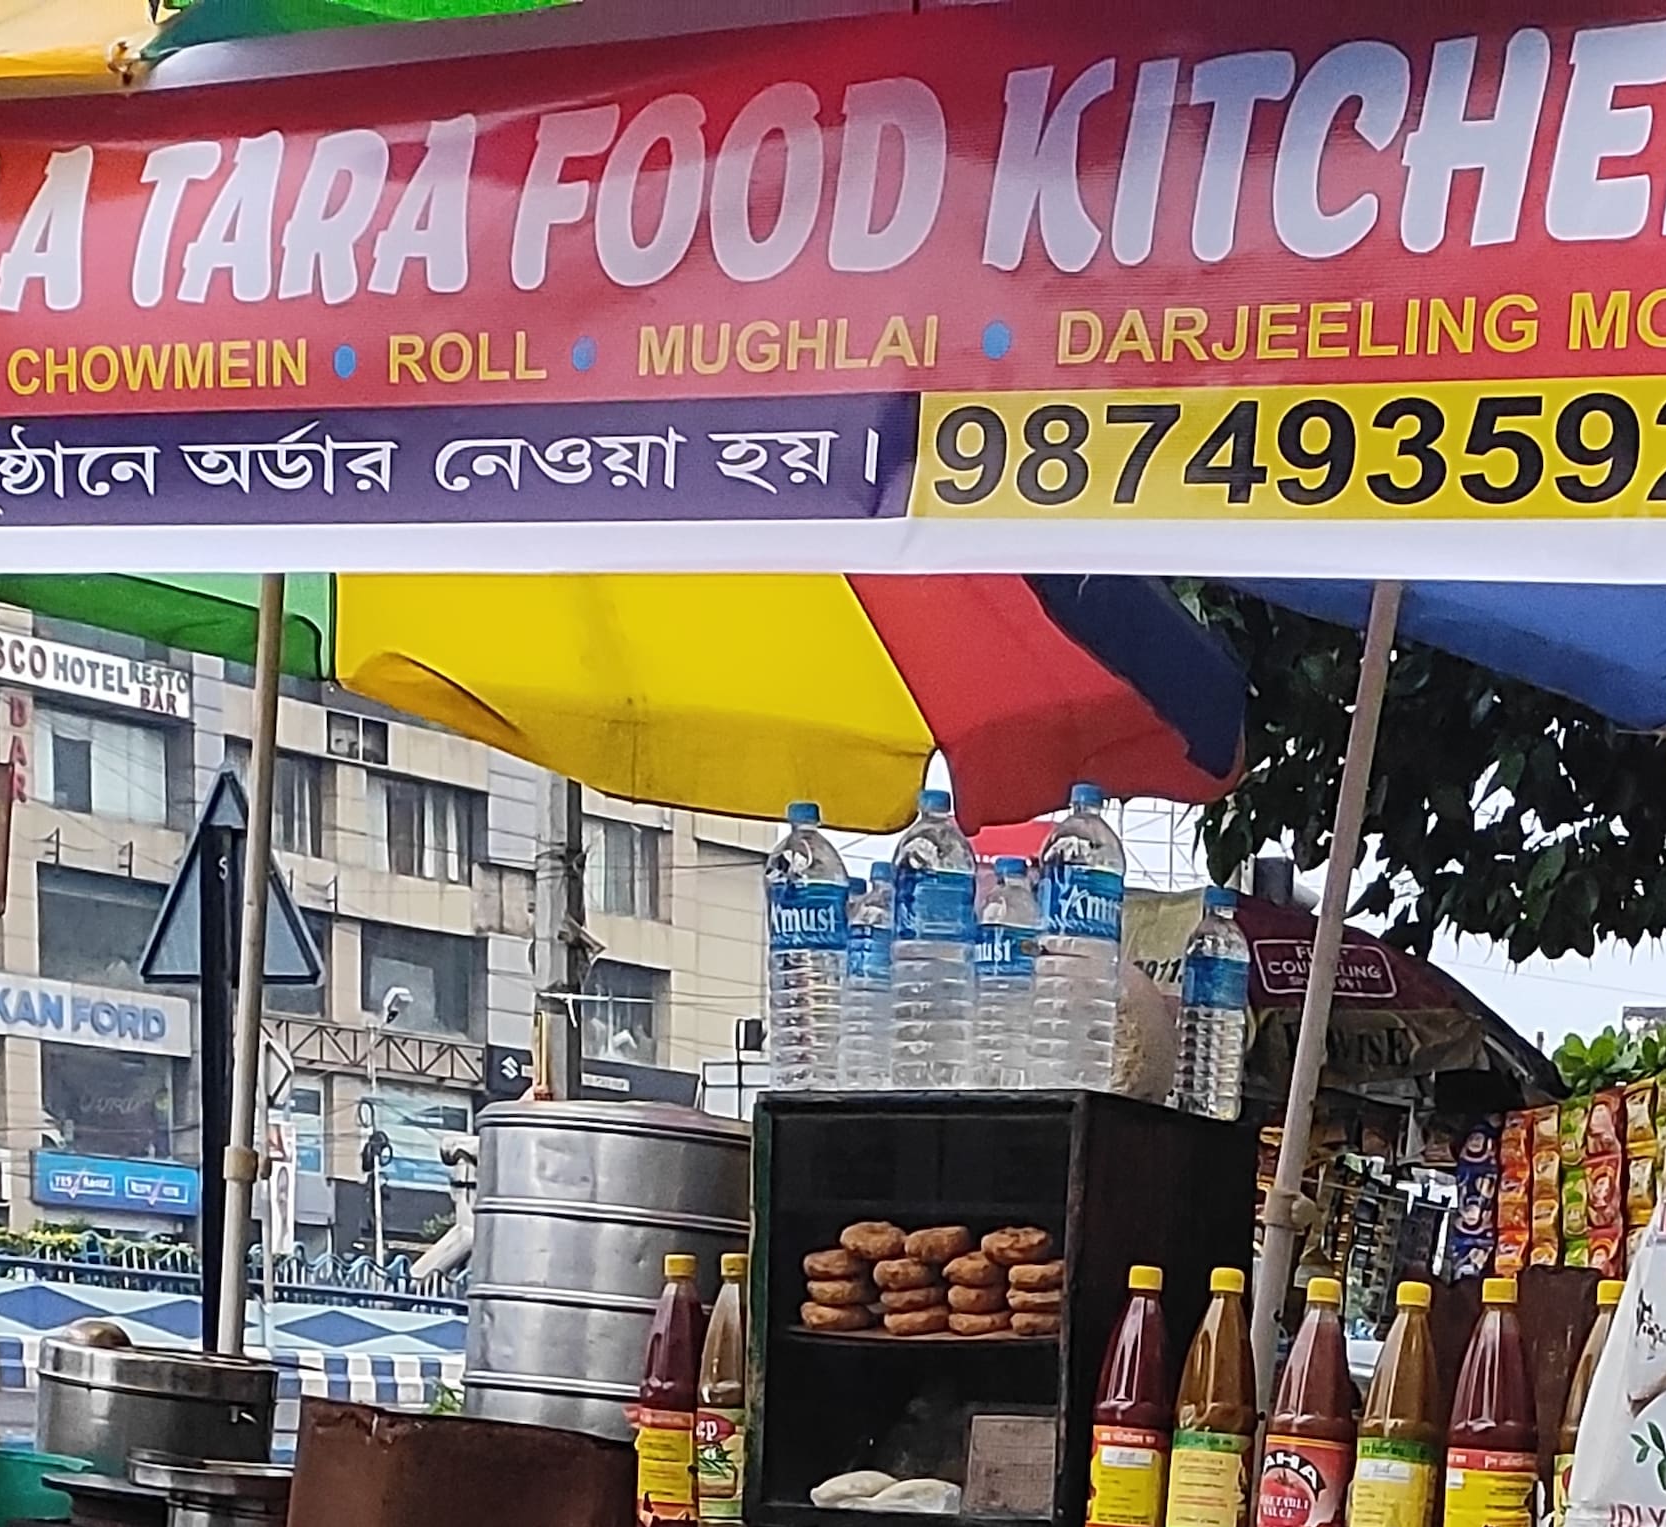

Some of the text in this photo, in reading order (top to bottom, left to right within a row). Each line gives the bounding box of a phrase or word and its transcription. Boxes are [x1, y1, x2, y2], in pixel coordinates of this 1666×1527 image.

[132, 114, 478, 308] TARA
[510, 74, 946, 291] FOOD
[7, 341, 308, 396] CHOWMEIN
[386, 333, 549, 384] ROLL
[637, 315, 938, 376] MUGHLAI
[1056, 295, 1538, 366] DARJEELING
[183, 421, 398, 493] অর্ডার
[435, 427, 688, 493] নেওয়া
[53, 652, 130, 695] HOTEL
[129, 661, 189, 695] RESTO
[139, 688, 179, 715] BAR
[71, 997, 167, 1041] FORD
